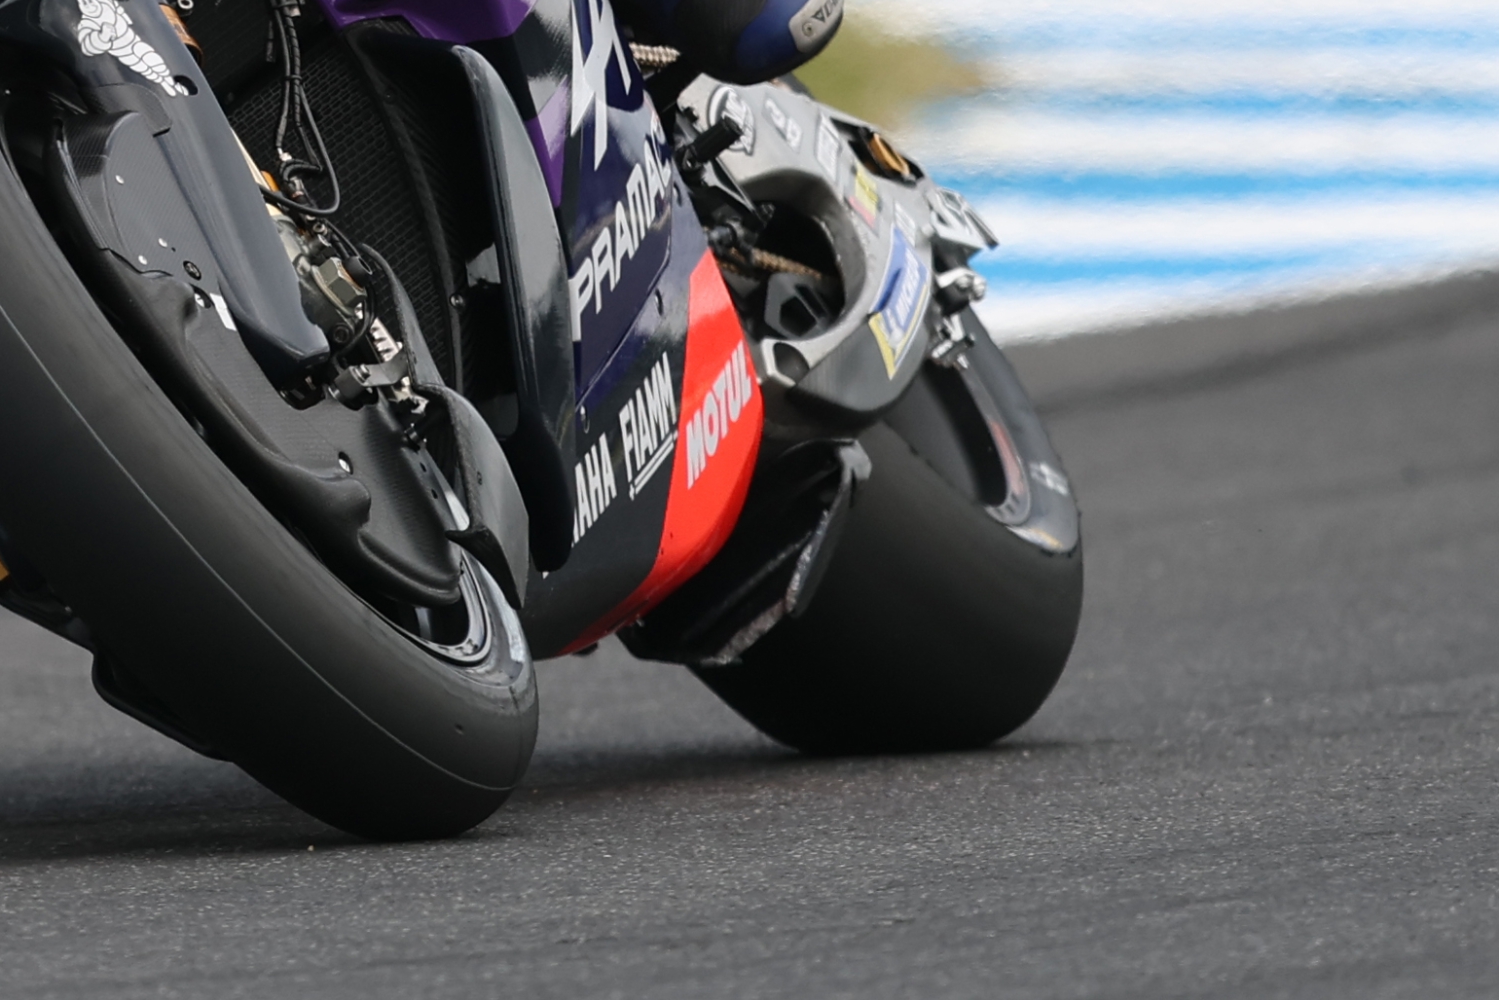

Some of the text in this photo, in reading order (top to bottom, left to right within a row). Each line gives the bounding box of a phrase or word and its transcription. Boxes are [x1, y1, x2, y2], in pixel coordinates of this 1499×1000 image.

[568, 112, 672, 342] PRAMAC
[619, 351, 677, 484] FIAMM
[686, 340, 753, 490] MOTUL
[571, 432, 618, 548] AHA
